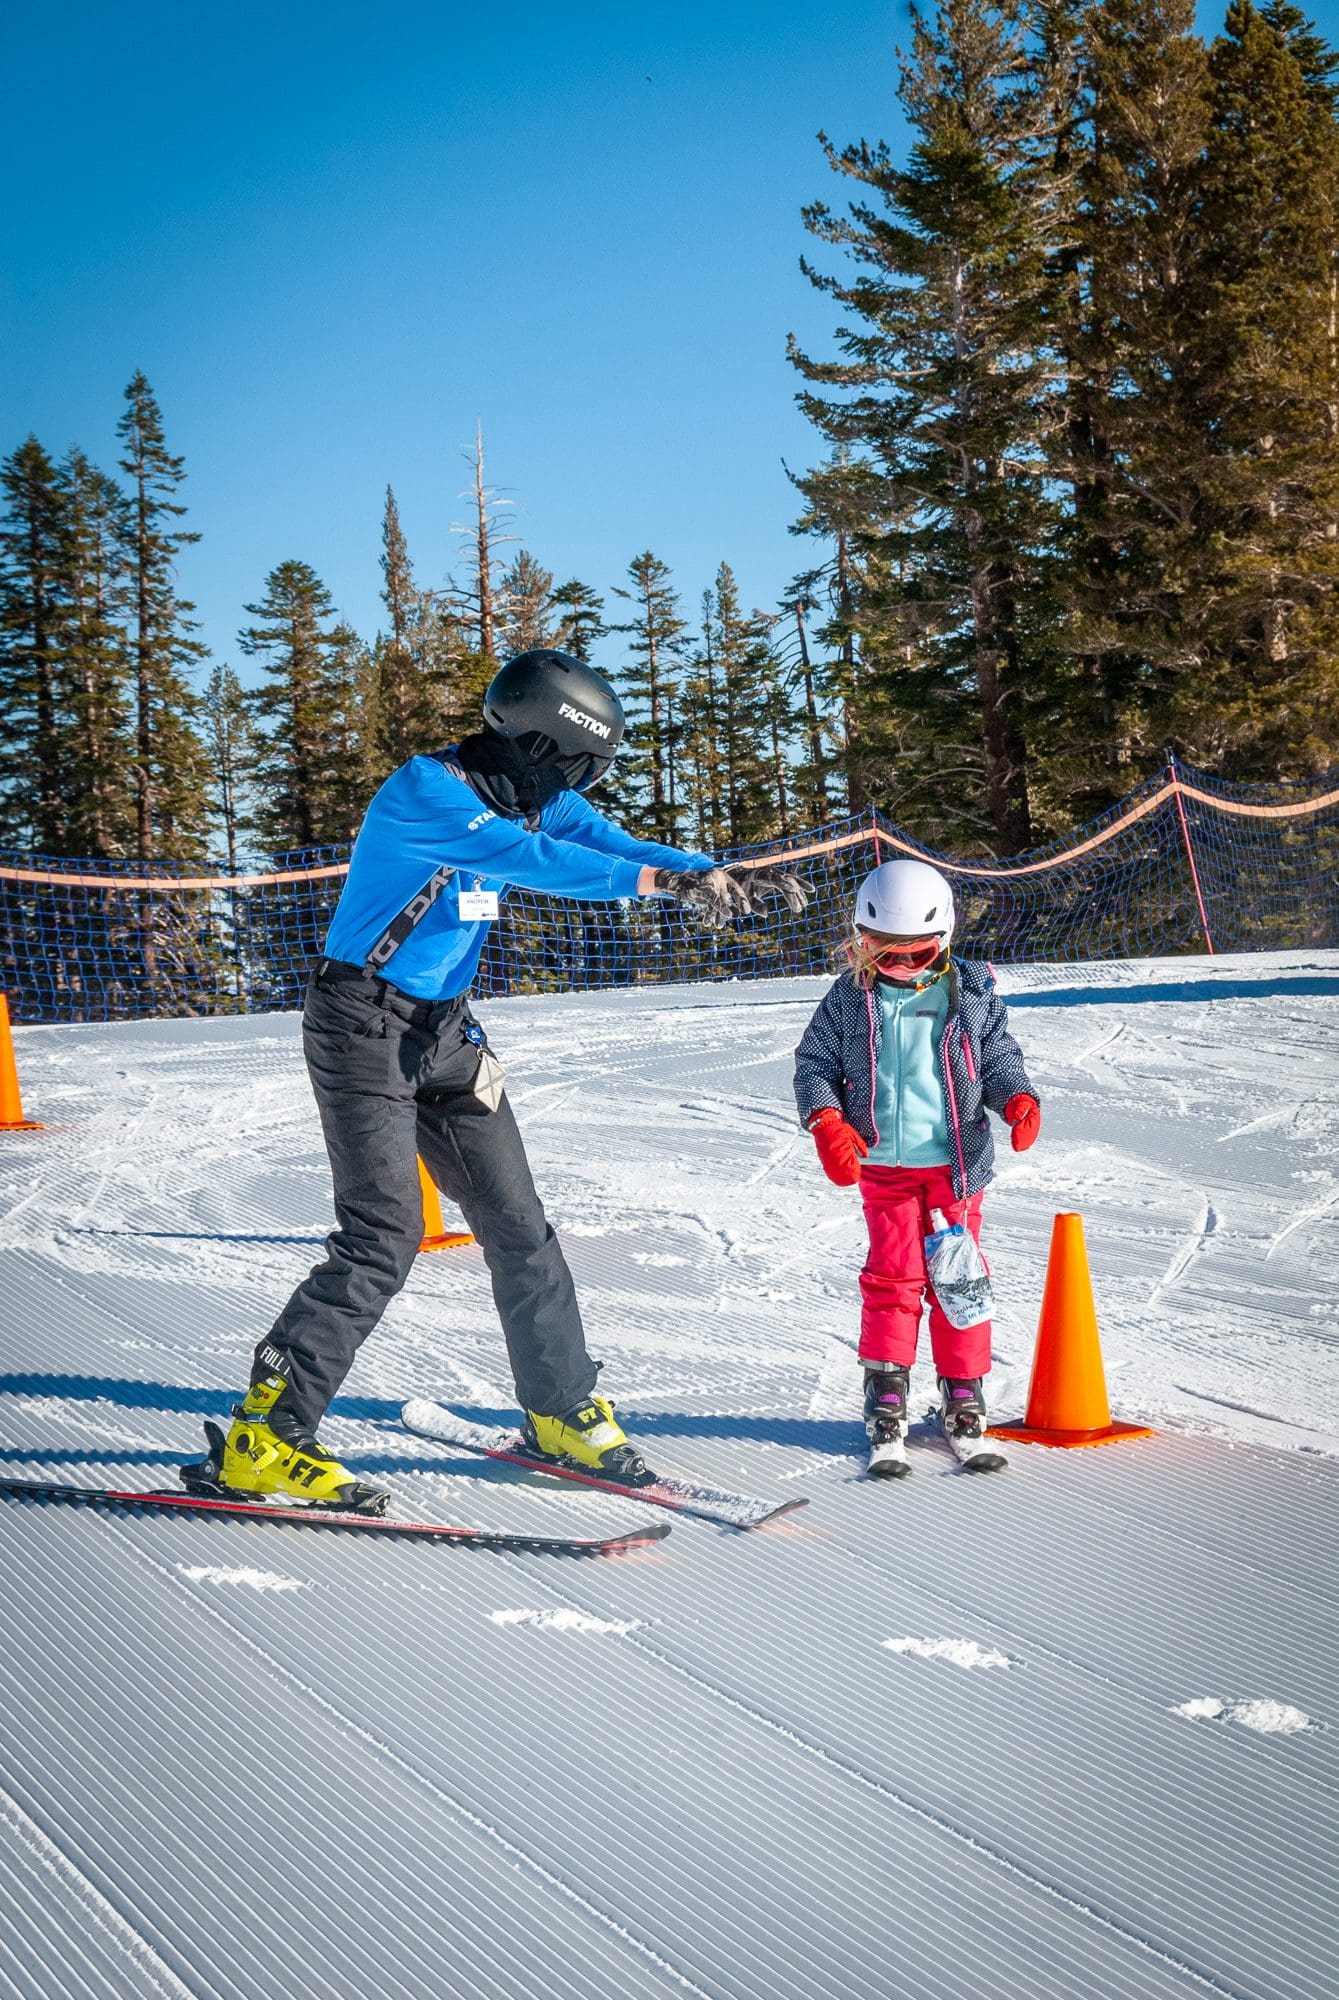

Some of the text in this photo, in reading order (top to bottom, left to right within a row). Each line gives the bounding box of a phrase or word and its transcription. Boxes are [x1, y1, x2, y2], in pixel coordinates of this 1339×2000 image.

[558, 703, 611, 739] FACTION
[260, 1345, 285, 1371] FULL
[577, 1407, 597, 1424] FT
[288, 1458, 328, 1488] FT
